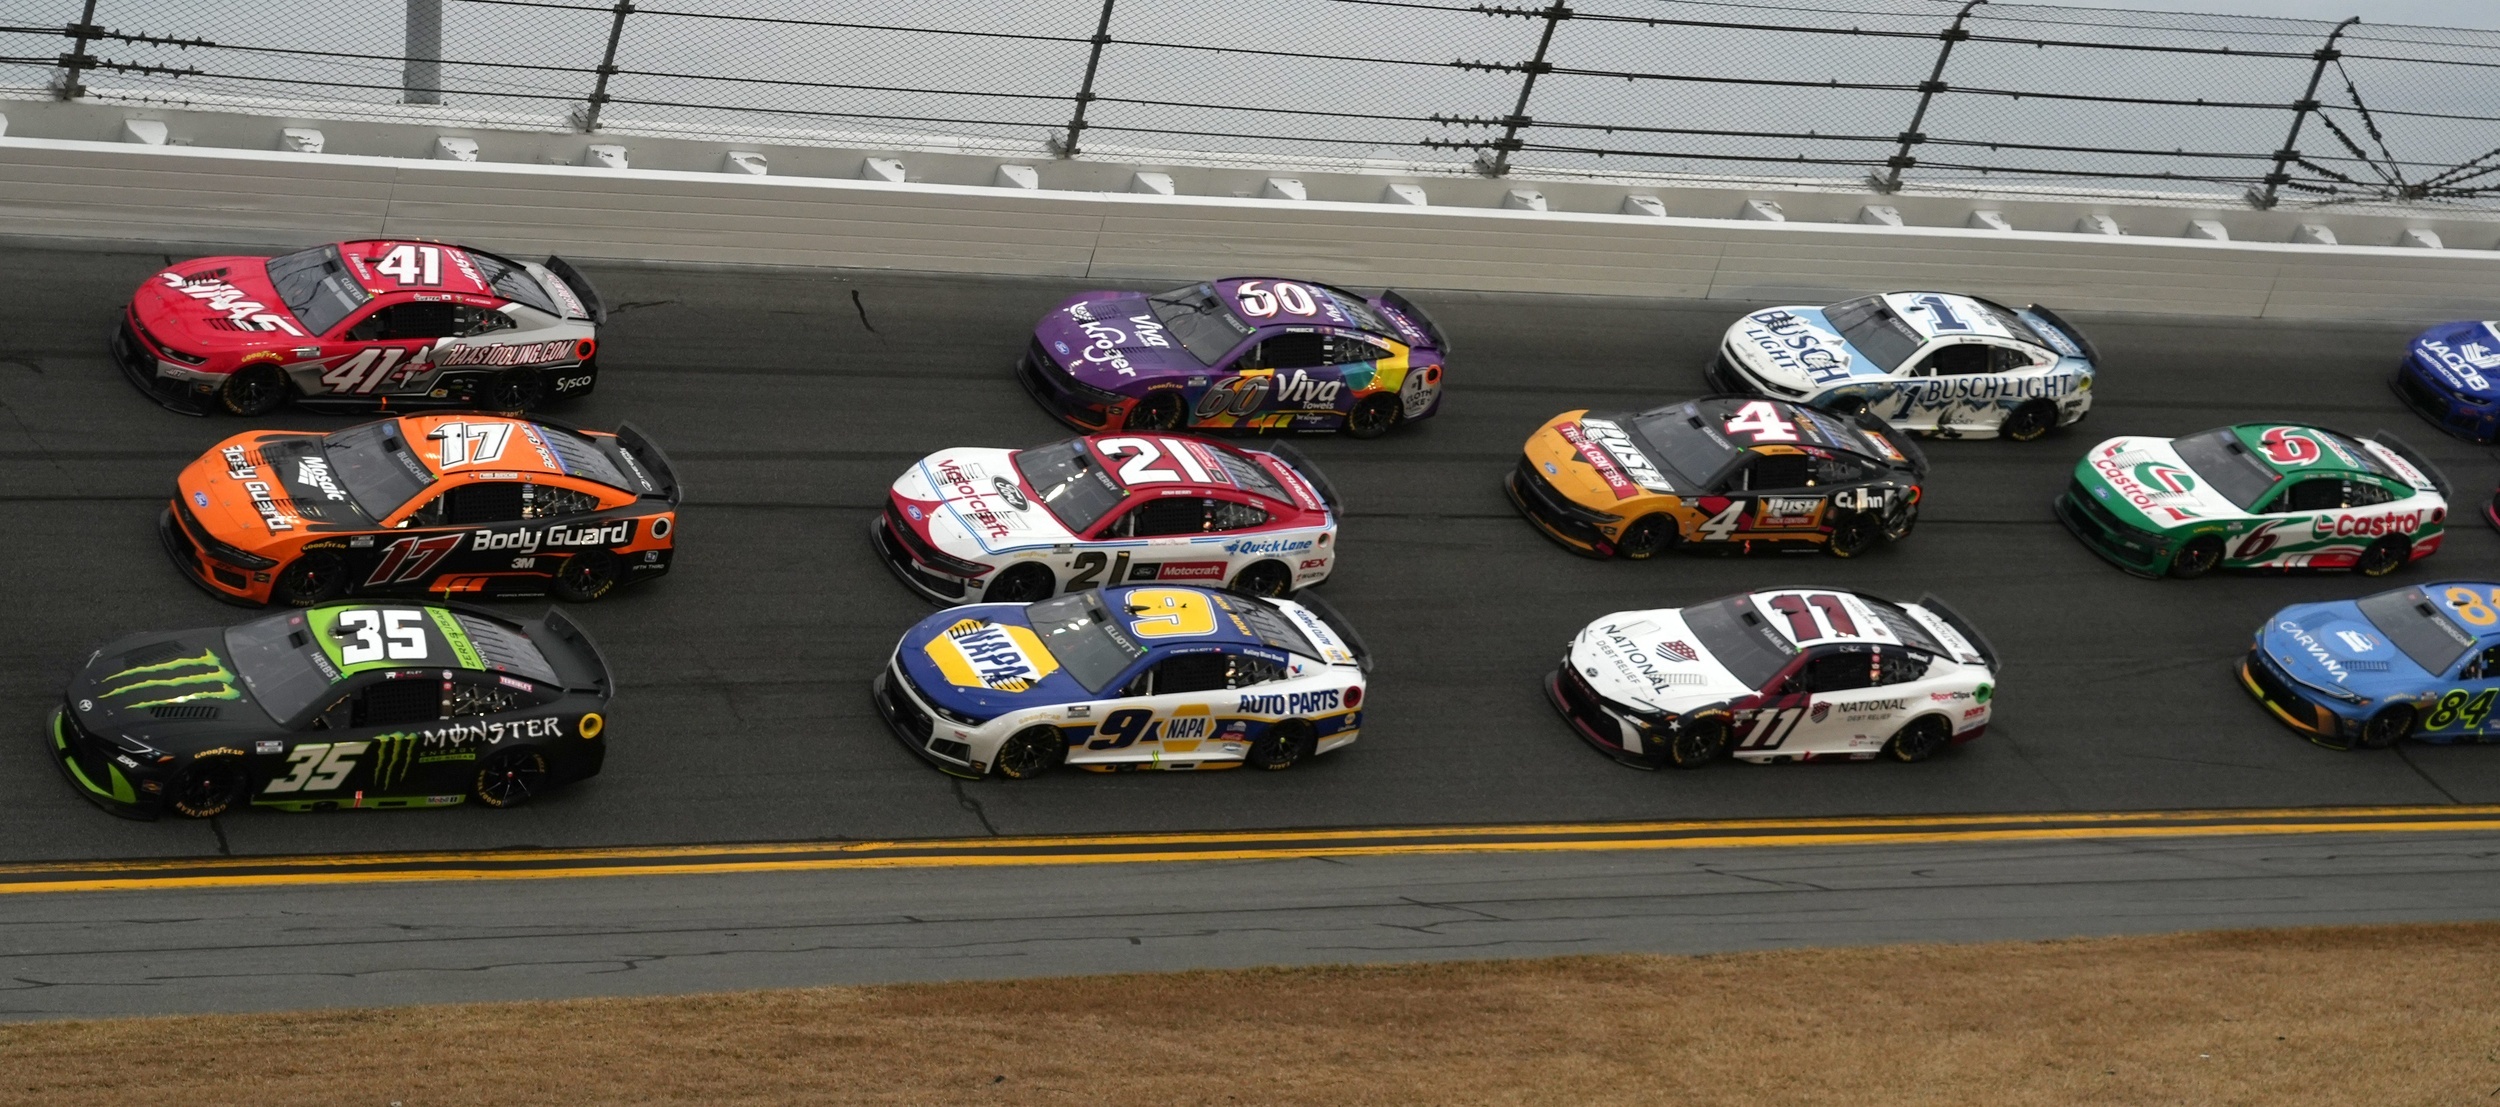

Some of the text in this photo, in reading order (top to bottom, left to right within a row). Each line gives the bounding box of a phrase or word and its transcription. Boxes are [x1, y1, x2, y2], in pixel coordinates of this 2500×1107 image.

[376, 244, 442, 286] 41
[341, 277, 364, 302] CUSTER
[1236, 281, 1317, 318] 60
[1129, 314, 1170, 349] Viva
[1914, 295, 1970, 332] 1
[241, 350, 284, 363] GOODYEAR
[1745, 329, 1801, 371] LIGHT
[1749, 310, 1851, 386] BUSCH
[2421, 339, 2490, 391] JACOB
[321, 346, 405, 394] 41
[1276, 369, 1341, 401] Viva
[2416, 348, 2464, 390] CONSTRUCTION
[1195, 375, 1272, 418] 60
[1302, 400, 1334, 410] Towels
[1890, 385, 1921, 420] 1
[1927, 374, 2072, 402] BUSCH LIGHT
[1724, 400, 1801, 442] 4
[428, 421, 514, 470] 17
[1097, 437, 1213, 485] 21
[2261, 426, 2321, 466] 6
[302, 456, 347, 502] Mosaic
[396, 451, 431, 485] BUESCHER
[1095, 471, 1119, 492] BERRY
[2096, 459, 2159, 510] Castrol
[994, 480, 1027, 508] Ford
[472, 521, 627, 554] Body Guard
[1699, 500, 1747, 541] 4
[2336, 508, 2424, 537] Castrol
[303, 541, 347, 550] GOODYEAR
[1239, 539, 1312, 554] Quick Lane
[2233, 519, 2287, 561] 6
[363, 532, 468, 587] 17
[511, 557, 535, 569] 3M
[1064, 551, 1131, 594] 21
[1163, 564, 1221, 577] Motorcraft
[1300, 558, 1328, 570] DEX
[1126, 588, 1218, 638] 9
[1769, 594, 1860, 643] 11
[2431, 616, 2471, 647] JOHNSON
[339, 610, 428, 666] 35
[957, 625, 1033, 683] NAPA
[1104, 624, 1135, 654] ELLIOTT
[1761, 627, 1792, 656] HAMLIN
[2279, 621, 2349, 683] CARVANA
[311, 651, 341, 686] HERBST
[1596, 640, 1642, 684] DEBT RELIEF
[1600, 624, 1671, 695] NATIONAL
[1237, 689, 1340, 715] AUTO PARTS
[1838, 699, 1907, 713] NATIONAL
[2425, 687, 2500, 731] 84
[423, 717, 563, 748] MONSTER
[1088, 707, 1154, 750] 9
[1166, 717, 1206, 739] NAPA
[1740, 708, 1803, 748] 11
[194, 747, 245, 759] GOODYEAR
[263, 741, 371, 794] 35
[420, 747, 477, 757] ENERGY
